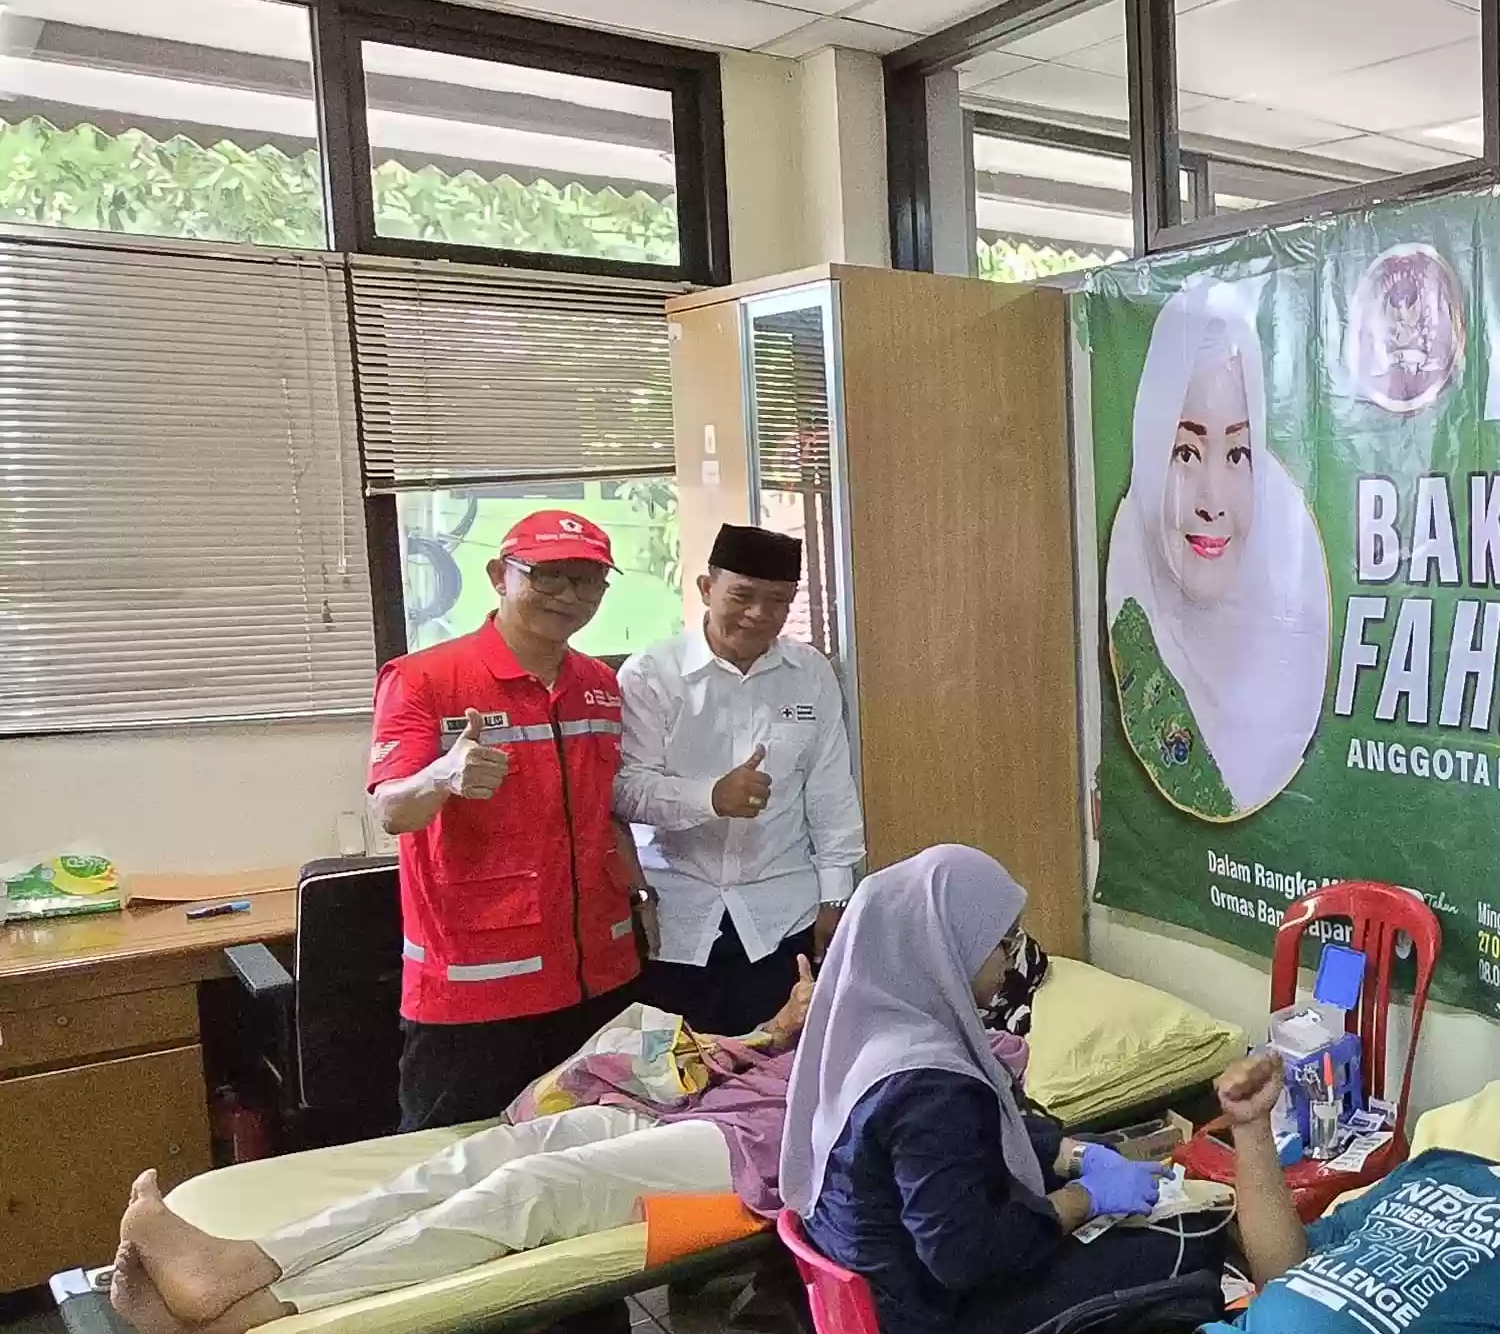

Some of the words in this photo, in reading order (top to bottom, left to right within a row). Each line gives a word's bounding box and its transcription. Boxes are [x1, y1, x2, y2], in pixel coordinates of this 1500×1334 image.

[1347, 738, 1491, 787] ANGGOTA
[1207, 849, 1252, 883] Dalam
[1254, 862, 1317, 899] Rangka
[1210, 884, 1256, 918] Ormas
[1257, 899, 1285, 929] Ban
[1302, 920, 1353, 944] apar
[1478, 930, 1490, 954] 27
